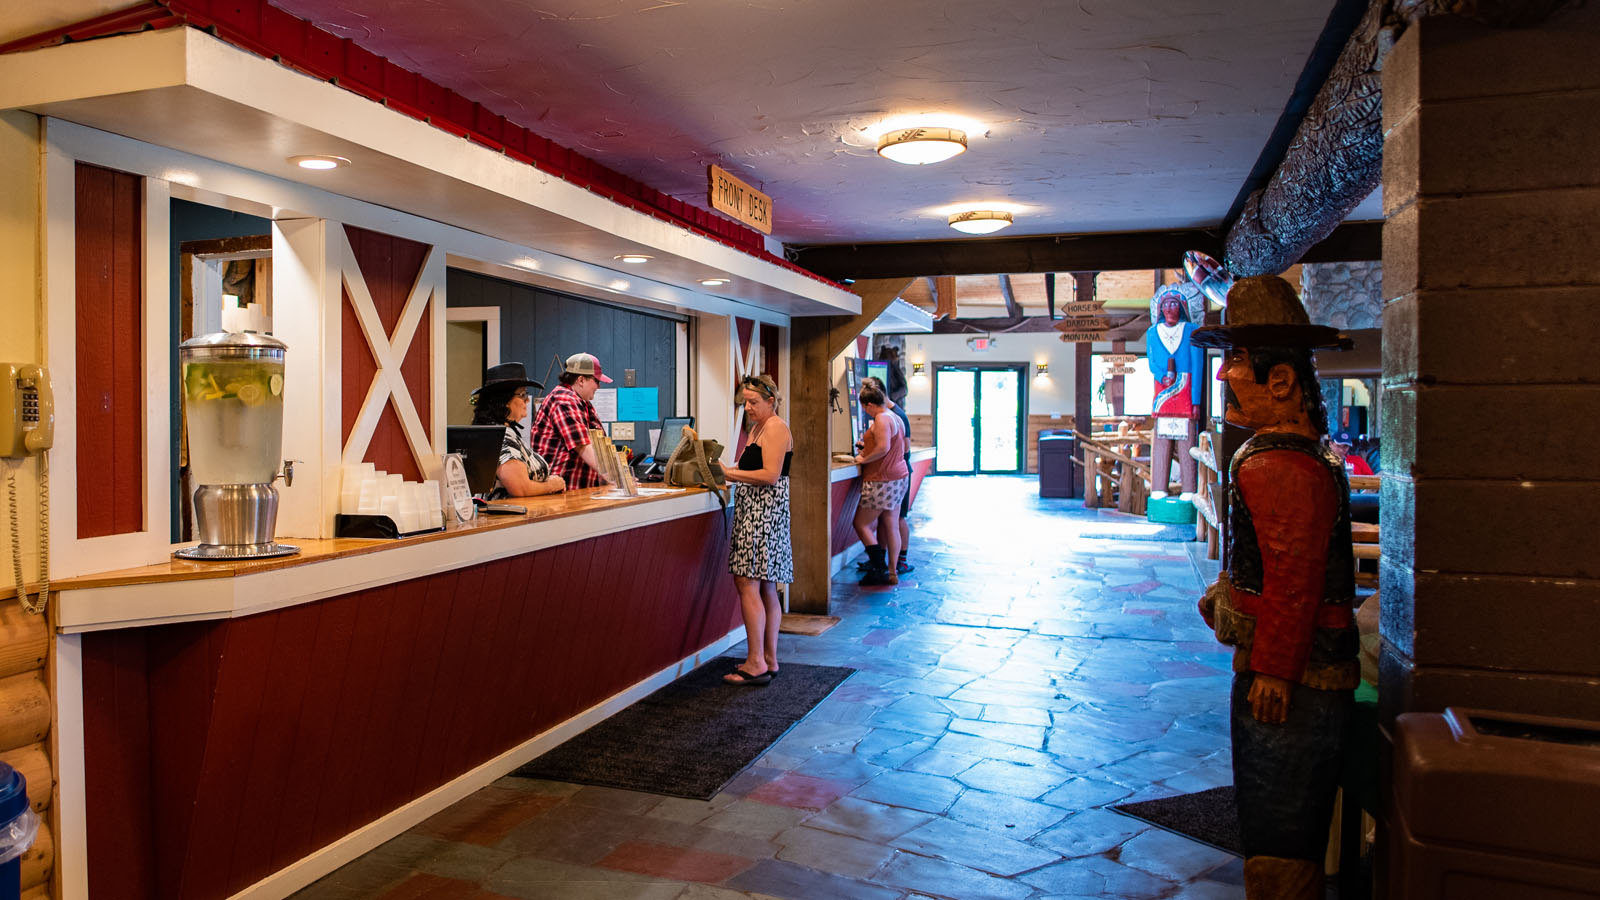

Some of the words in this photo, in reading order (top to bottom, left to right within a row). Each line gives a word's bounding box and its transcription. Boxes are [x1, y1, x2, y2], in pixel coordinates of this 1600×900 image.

[718, 176, 744, 212] FRONT
[749, 193, 768, 225] DESK
[1067, 304, 1098, 312] HORSES
[1066, 319, 1100, 327] DAKOTAS
[1063, 333, 1101, 341] MONTANA
